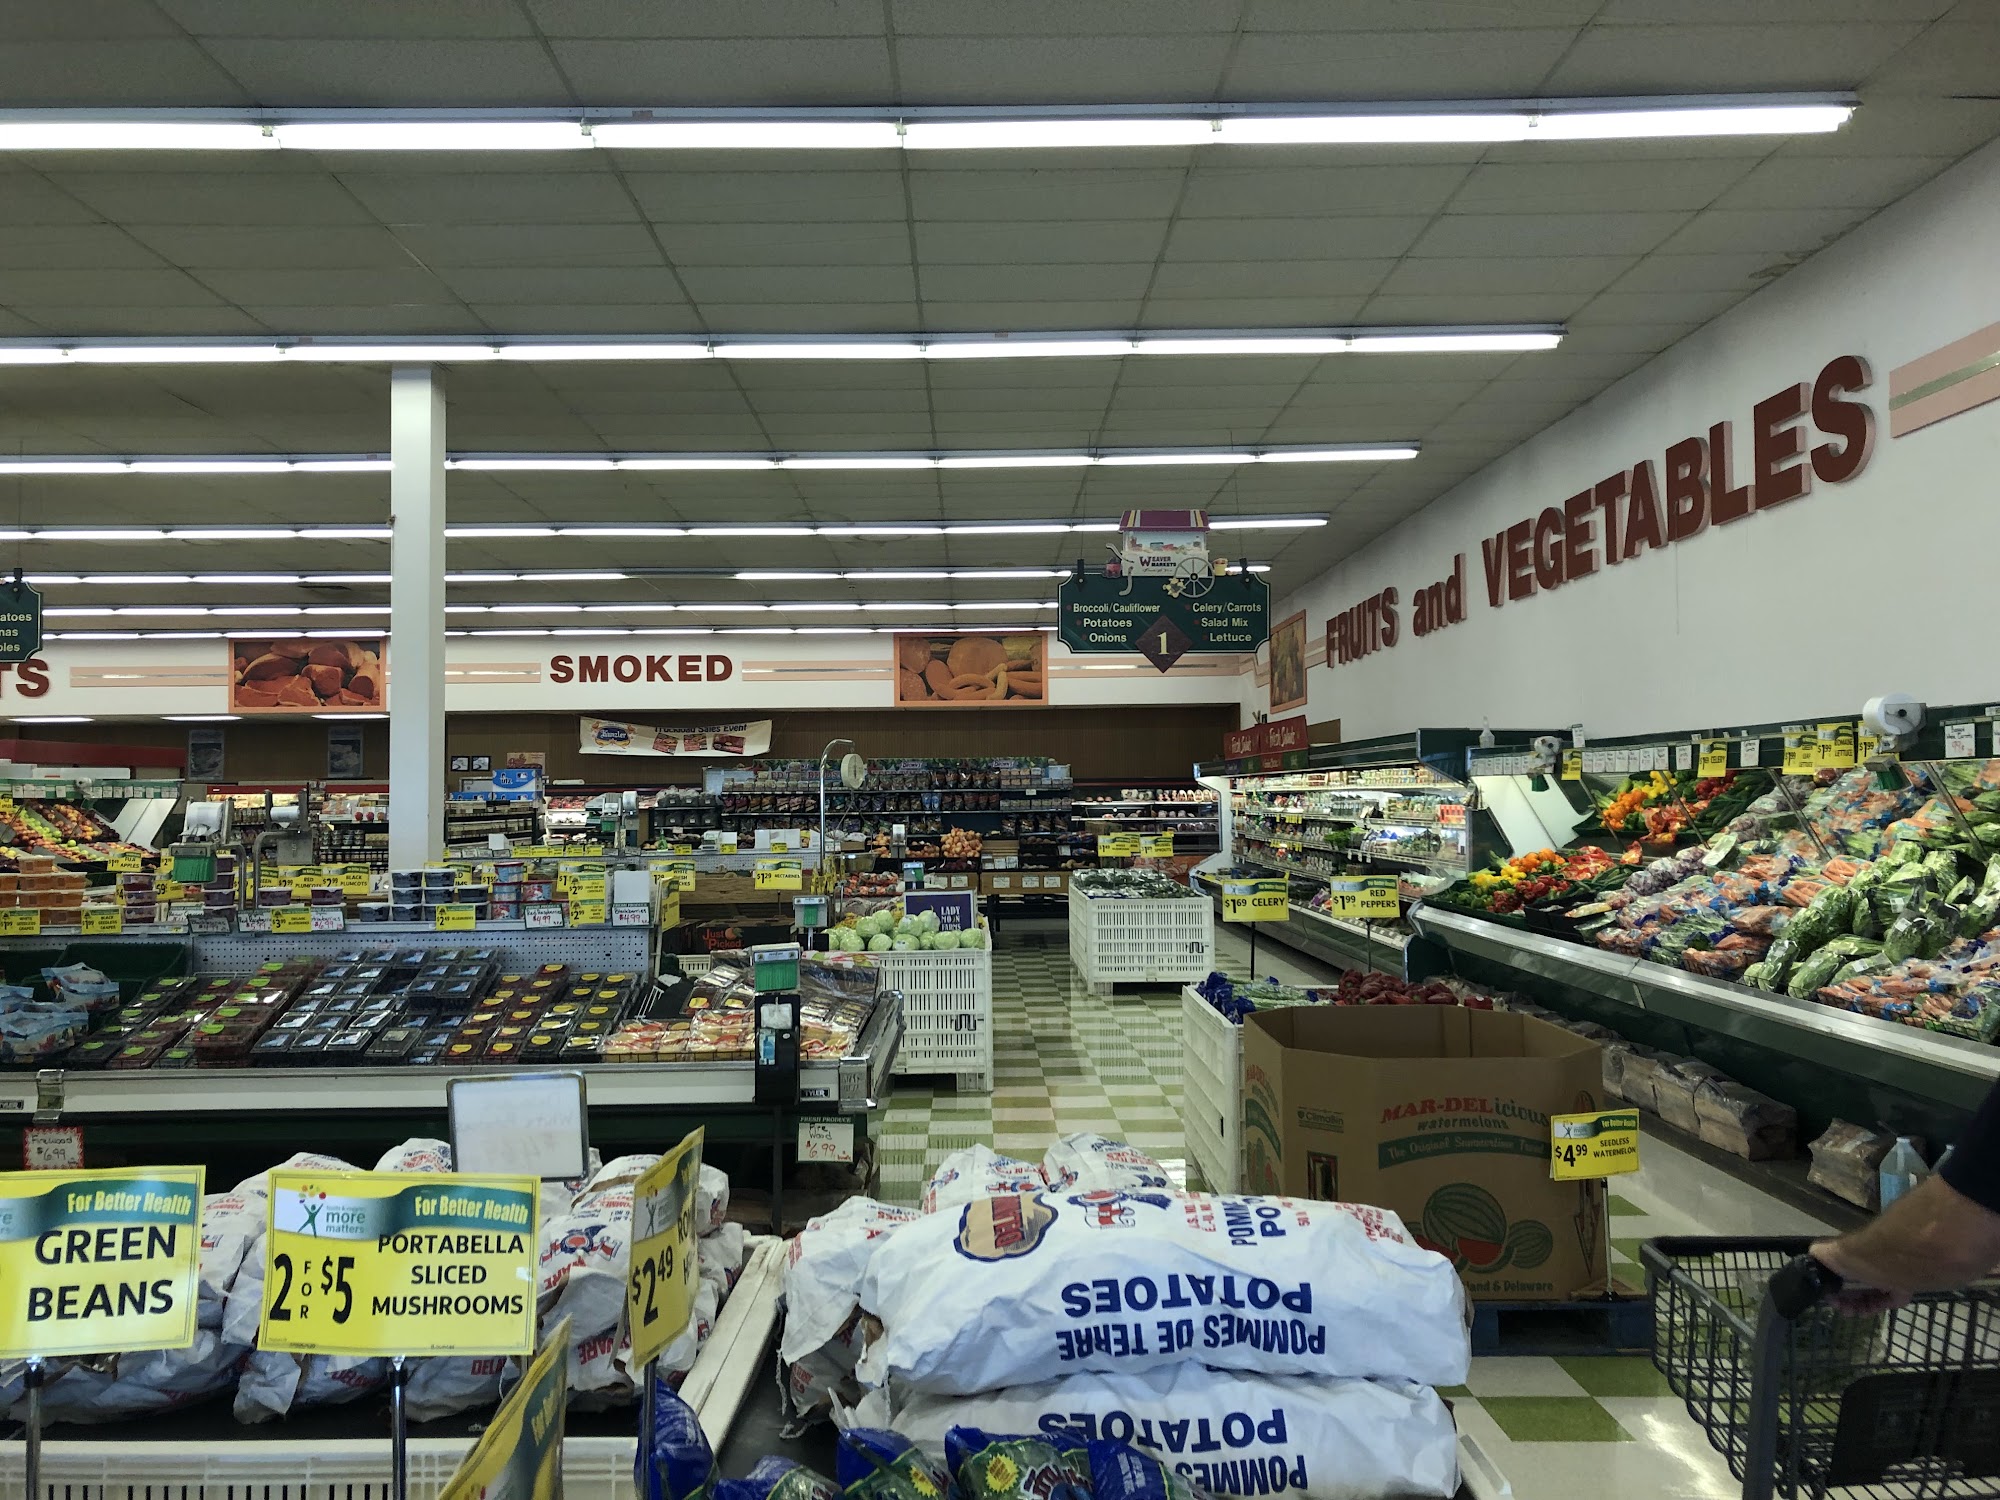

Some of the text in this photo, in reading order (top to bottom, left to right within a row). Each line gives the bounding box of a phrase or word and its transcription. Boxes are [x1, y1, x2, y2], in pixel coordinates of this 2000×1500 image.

[1326, 355, 1875, 668] FRUITS and VEGETABLES
[1073, 603, 1160, 613] Broccoli/Cauliflower
[1192, 602, 1261, 613] Celery/Carrots
[1083, 618, 1132, 627] Potatoes
[1201, 618, 1248, 627] Salad Mix
[1089, 632, 1127, 642] Onions
[1157, 632, 1169, 655] 1
[1209, 632, 1251, 642] Lettuce
[550, 655, 733, 683] SMOKED
[1225, 899, 1247, 913] $169
[1252, 898, 1285, 907] CELERY
[1334, 895, 1356, 910] $199
[1361, 900, 1396, 908] PEPPERS
[941, 906, 960, 915] LADY
[703, 928, 724, 940] Just
[708, 938, 742, 949] Picked
[804, 1088, 825, 1097] TYLER
[1417, 1116, 1510, 1131] watermelons
[1600, 1138, 1630, 1148] SEEDLESS
[1555, 1144, 1588, 1167] $499
[1593, 1146, 1636, 1158] WATERMELON
[67, 1190, 192, 1216] For Better Health
[326, 1211, 366, 1224] more
[415, 1196, 529, 1225] For Better Health
[325, 1224, 364, 1234] matters
[35, 1225, 177, 1265] GREEN
[378, 1234, 524, 1254] PORTABELLA
[411, 1265, 487, 1285] SLICED
[269, 1253, 293, 1321] 2
[321, 1256, 355, 1324] $5
[1061, 1273, 1313, 1318] POTATOES
[27, 1279, 174, 1322] BEANS
[372, 1295, 524, 1316] MUSHROOMS
[1056, 1314, 1326, 1361] POMMES DE TERRE
